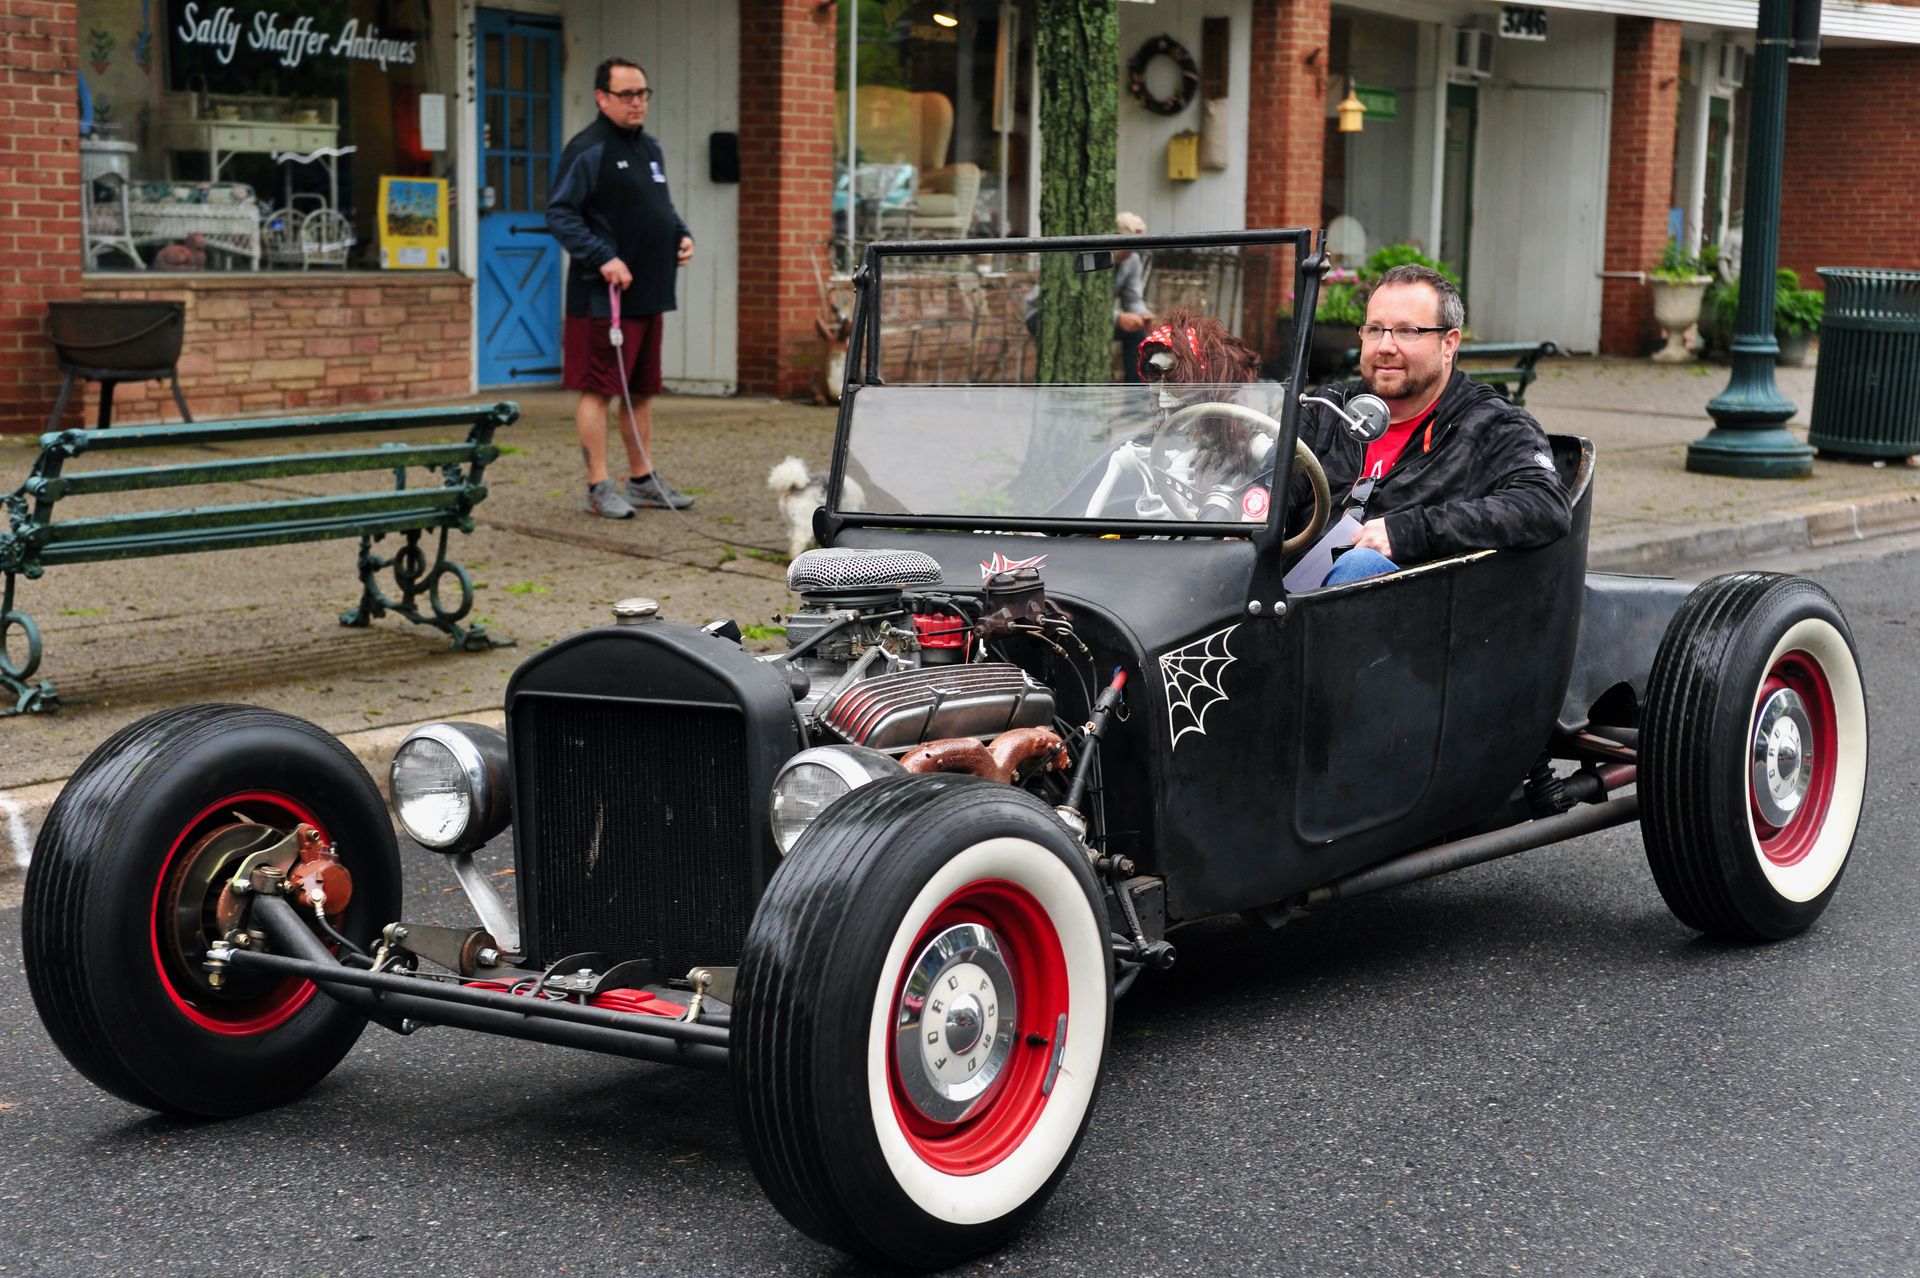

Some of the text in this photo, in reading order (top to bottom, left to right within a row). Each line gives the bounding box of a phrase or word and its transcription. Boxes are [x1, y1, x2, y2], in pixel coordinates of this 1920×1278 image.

[178, 2, 416, 70] Sally Shaffer Antiques
[1502, 5, 1547, 35] 3746
[928, 975, 959, 1070] FORD
[967, 978, 995, 1073] FORD
